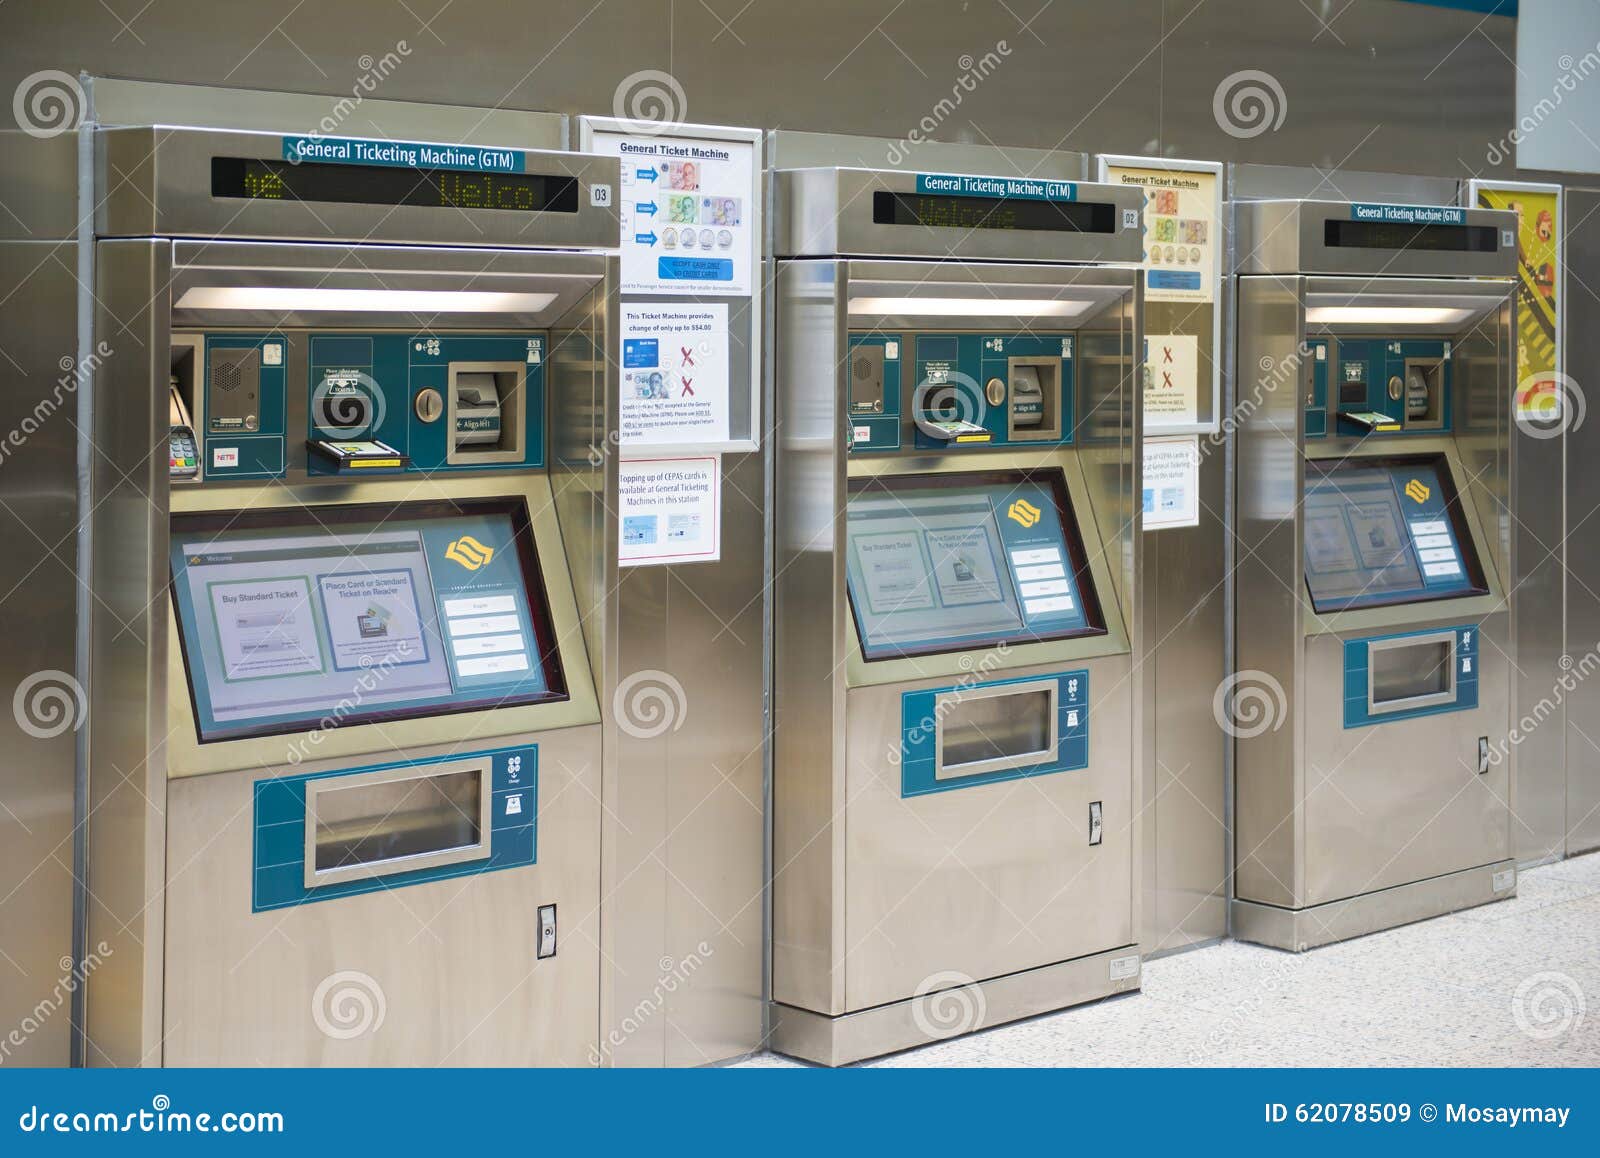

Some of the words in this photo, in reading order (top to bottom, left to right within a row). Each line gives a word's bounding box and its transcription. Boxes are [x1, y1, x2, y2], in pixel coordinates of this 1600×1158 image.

[296, 140, 351, 158] General
[355, 142, 417, 166] Ticketing
[420, 147, 476, 166] Machine
[478, 149, 515, 170] (GTM)
[620, 142, 657, 154] General
[660, 145, 689, 156] Ticket
[691, 147, 729, 159] Machine
[1122, 174, 1148, 184] General
[1150, 177, 1170, 186] Ticket
[1173, 179, 1200, 188] Machine
[440, 174, 533, 209] Welco
[924, 176, 961, 191] General
[963, 178, 1005, 196] Ticketing
[1007, 181, 1044, 196] Machine
[1045, 183, 1071, 199] (GTM)
[594, 188, 607, 201] 03
[1125, 213, 1135, 224] 02
[1357, 206, 1383, 218] General
[1384, 208, 1414, 222] Ticketing
[1415, 209, 1442, 222] Machine
[1443, 211, 1461, 223] (GTM)
[689, 313, 714, 321] provides
[629, 325, 651, 333] change
[660, 325, 673, 333] only
[674, 325, 683, 333] up
[620, 474, 645, 484] Topping
[647, 474, 656, 483] up
[664, 472, 683, 480] CEPAS
[684, 472, 700, 480] cards
[648, 485, 654, 493] at
[656, 484, 680, 493] General
[681, 483, 709, 493] Ticketing
[627, 497, 657, 506] Machines
[678, 496, 700, 504] station
[326, 582, 346, 590] Place
[222, 595, 237, 604] Buy
[239, 592, 273, 602] Standard
[275, 591, 298, 599] Ticket
[339, 590, 360, 598] Ticket
[373, 588, 397, 596] Reader
